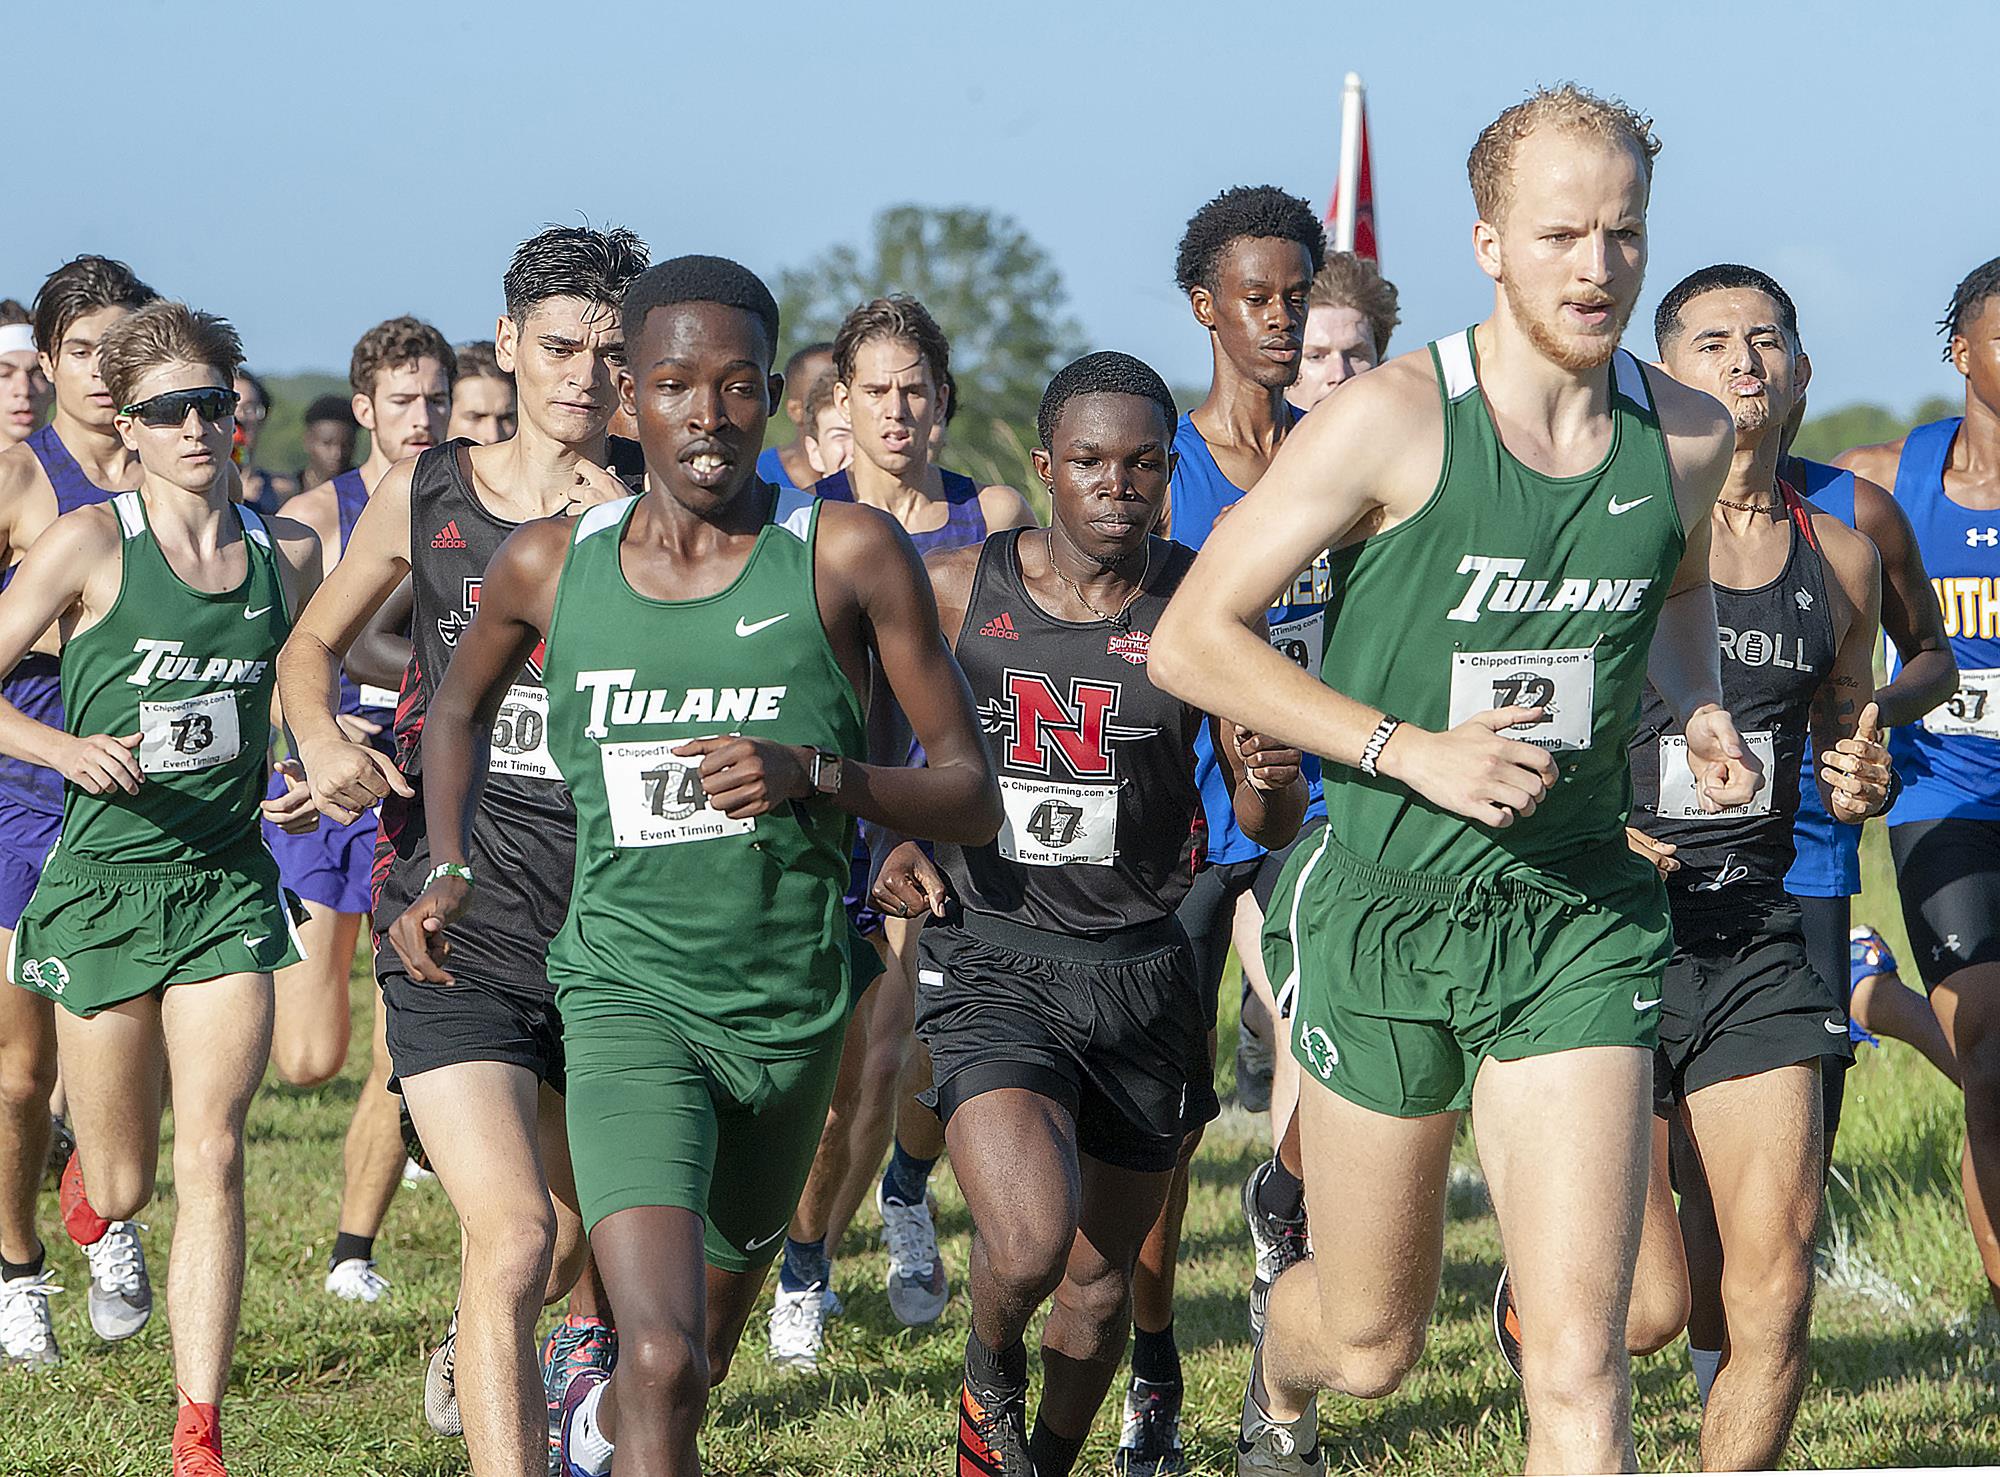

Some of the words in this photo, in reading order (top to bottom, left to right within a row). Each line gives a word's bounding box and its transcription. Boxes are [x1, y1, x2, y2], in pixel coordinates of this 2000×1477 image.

[431, 538, 467, 549] adidas
[979, 627, 1019, 641] adidas
[1471, 655, 1579, 668] ChippedTiming.com
[152, 694, 228, 713] ChippedTiming.com
[1492, 677, 1554, 722] 72
[170, 715, 214, 751] 73
[491, 708, 543, 751] 50
[617, 746, 672, 757] ChippedTi
[162, 758, 190, 769] Event
[193, 754, 220, 768] Timing
[490, 759, 508, 769] ent
[510, 760, 546, 775] Timing
[640, 767, 708, 815] 74
[1011, 782, 1105, 798] ChippedTiming.com
[640, 828, 676, 840] Event
[678, 822, 723, 836] Timing
[1026, 804, 1083, 843] 47
[1019, 849, 1049, 861] Event
[1052, 853, 1089, 863] Timing
